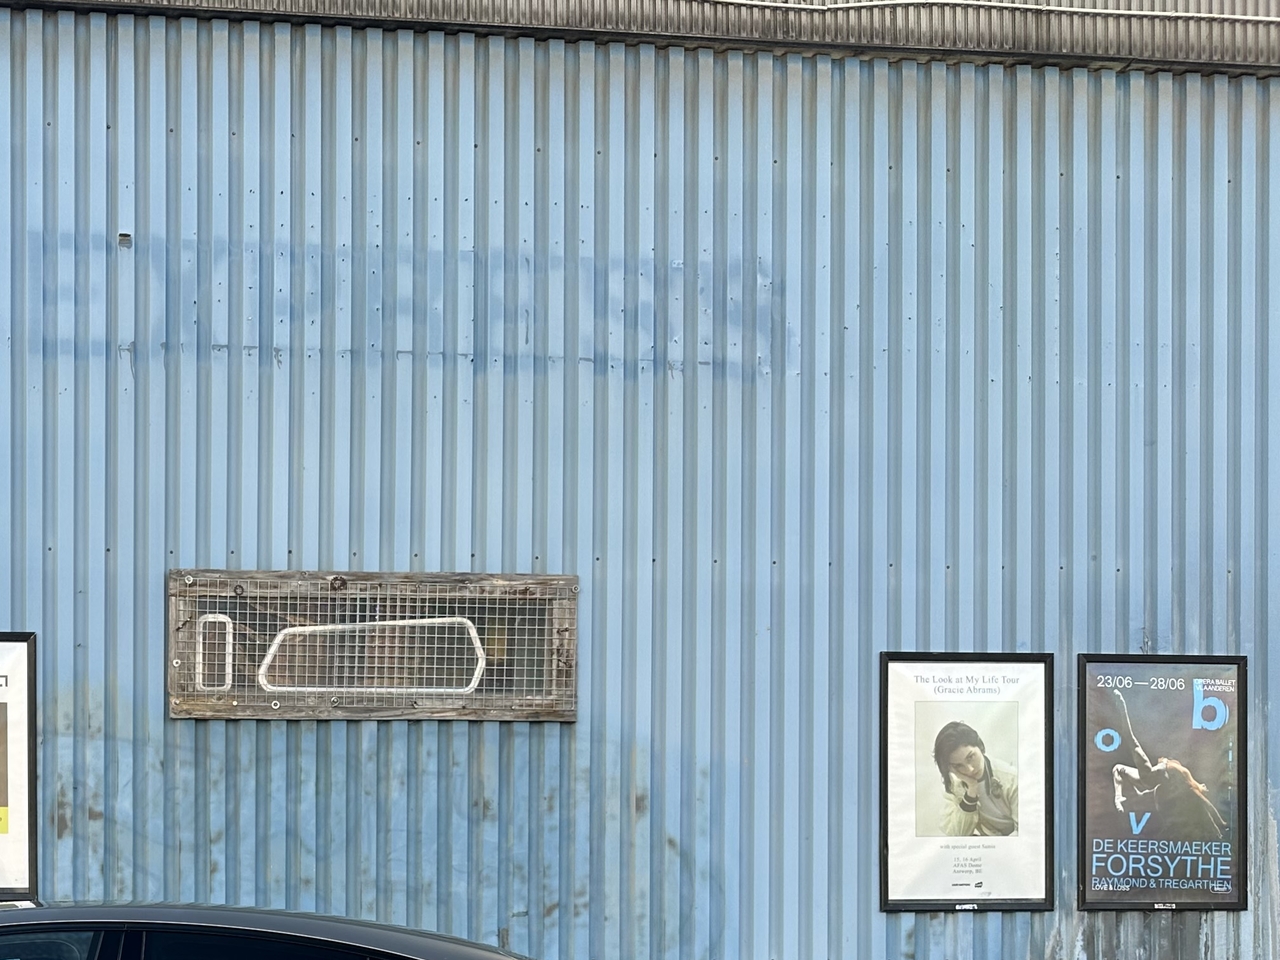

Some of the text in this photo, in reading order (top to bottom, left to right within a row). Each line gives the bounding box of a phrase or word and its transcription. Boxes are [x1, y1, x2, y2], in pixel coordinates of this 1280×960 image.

[26, 230, 798, 386] EXPRESS
[913, 675, 1020, 686] The Look at My Life Tour
[1215, 679, 1236, 687] BALLET
[933, 685, 1001, 695] (Gracie Abrams)
[1195, 684, 1235, 692] VLAANDEREN
[1192, 678, 1229, 731] b
[1092, 838, 1232, 856] DE KEERSMAEKER
[1091, 853, 1232, 879] FORSYTHE
[1091, 877, 1148, 889] RAYMOND
[1149, 878, 1157, 889] &
[1158, 879, 1232, 891] TREGARTHEN
[1113, 884, 1131, 892] LOSS
